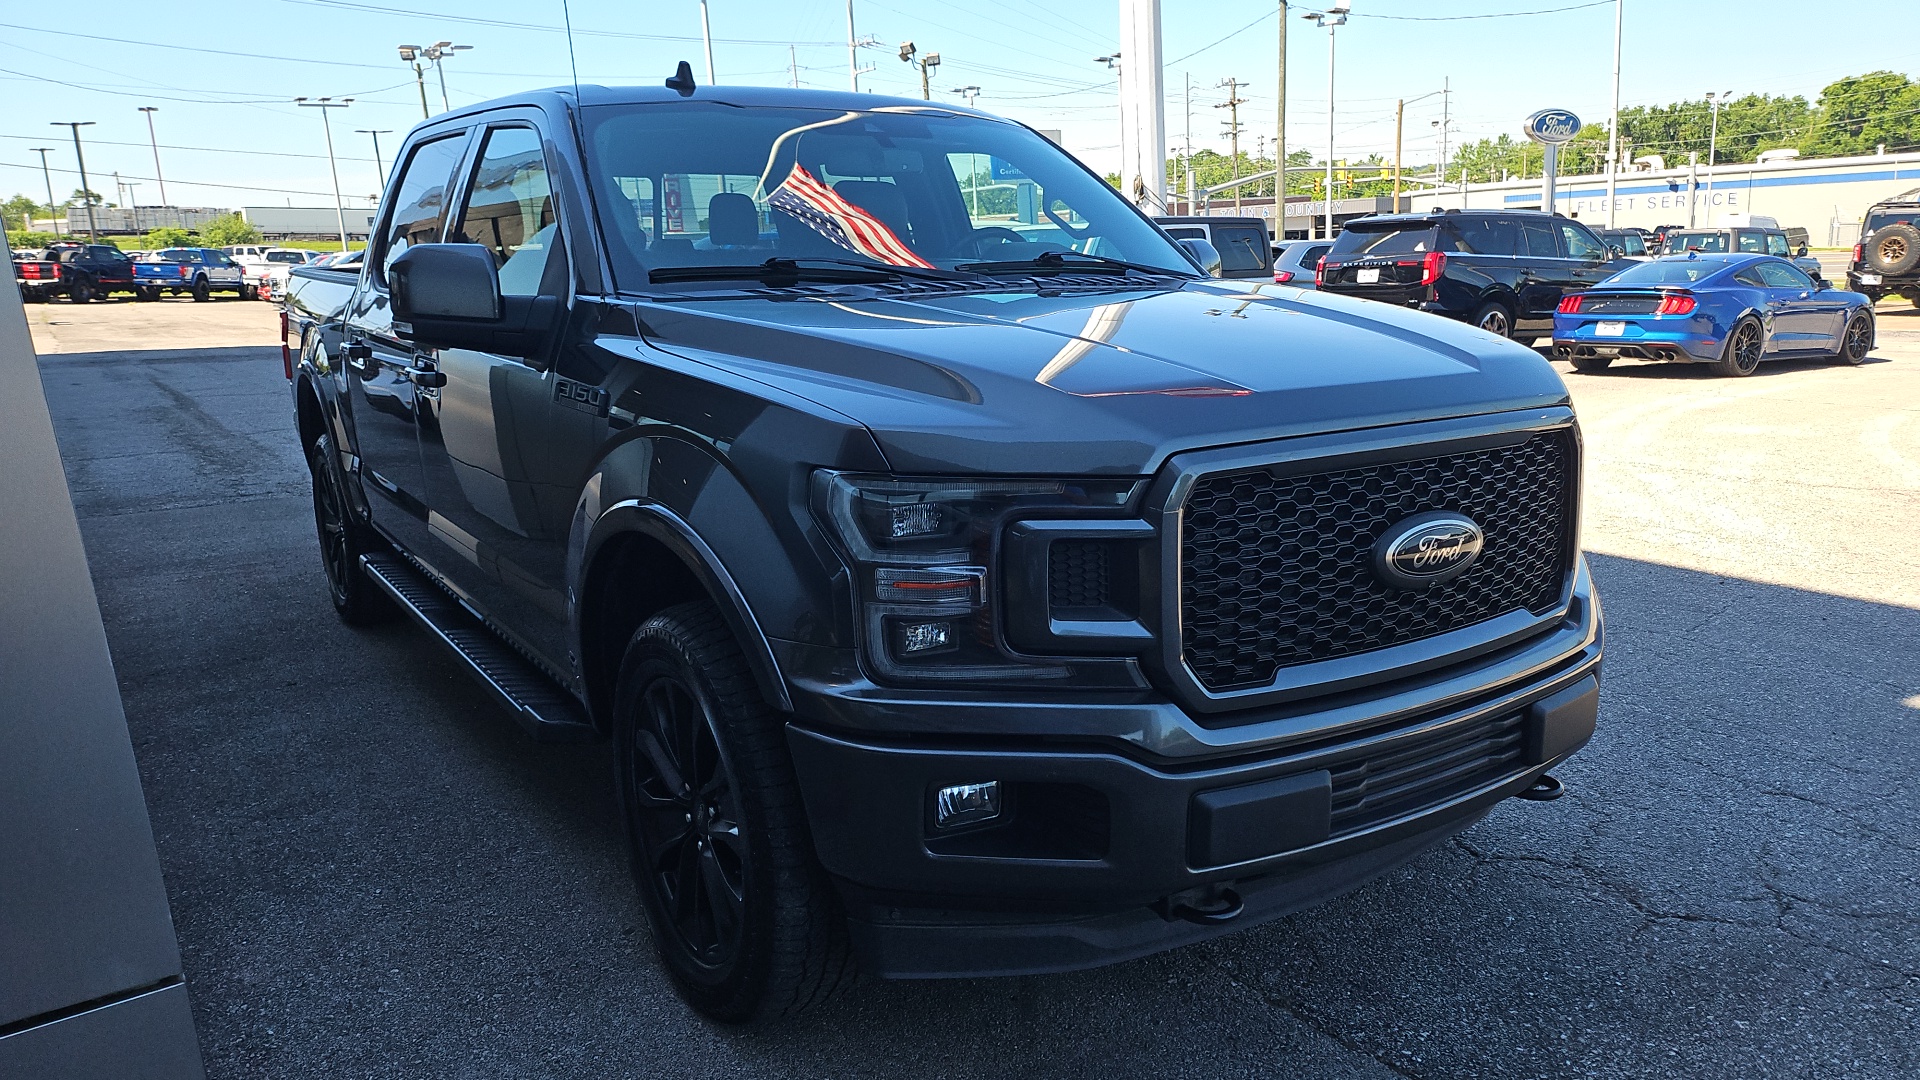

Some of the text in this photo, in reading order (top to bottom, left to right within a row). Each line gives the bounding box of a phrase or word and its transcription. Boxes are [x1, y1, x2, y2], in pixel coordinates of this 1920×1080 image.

[1542, 115, 1573, 136] Ford
[1262, 206, 1271, 218] &
[1285, 201, 1344, 217] OUNTY
[1577, 198, 1636, 213] FLEET
[1413, 533, 1465, 568] Ford
